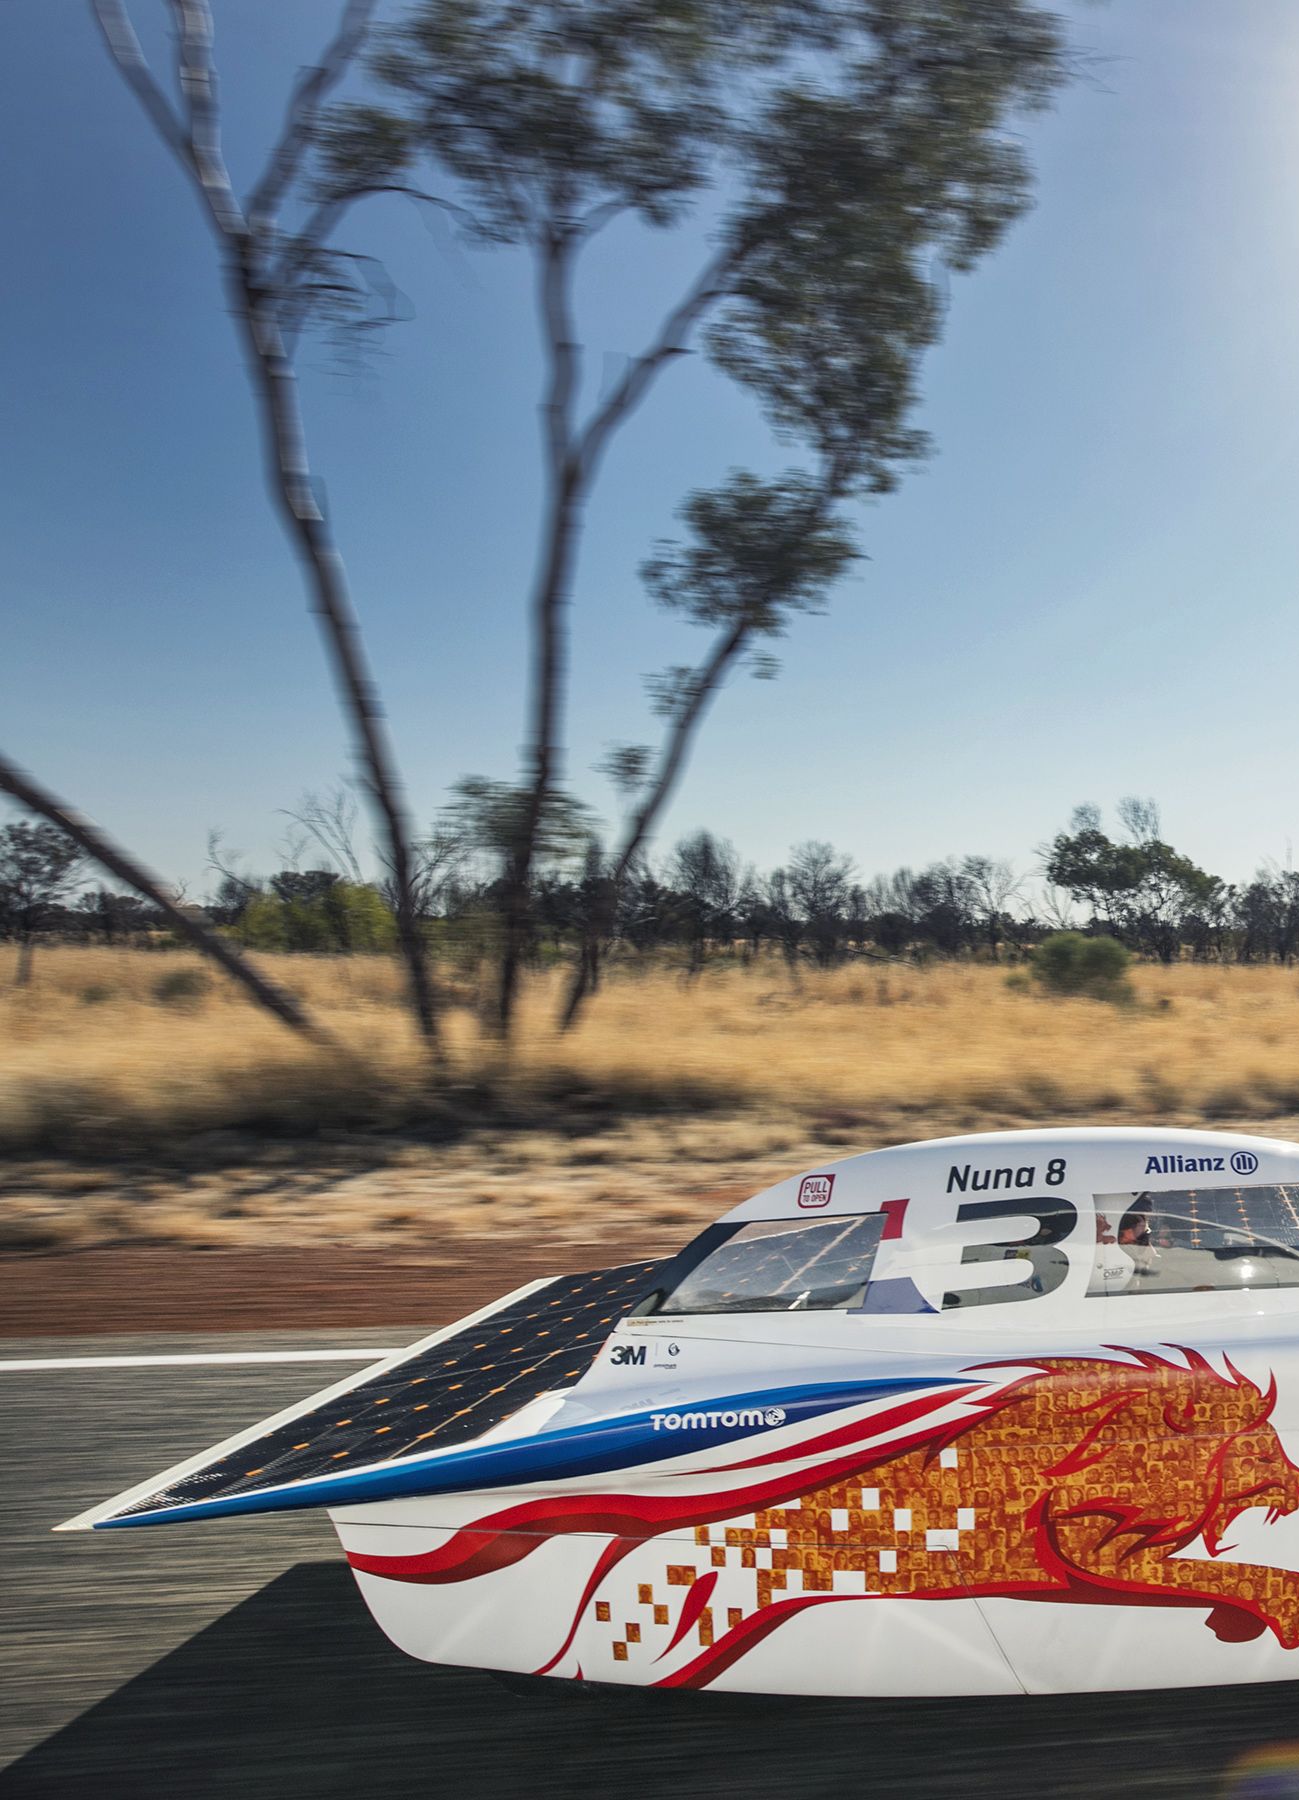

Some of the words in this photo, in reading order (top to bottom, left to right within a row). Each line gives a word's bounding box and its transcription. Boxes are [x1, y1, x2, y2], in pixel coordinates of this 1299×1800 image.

[1145, 1155, 1225, 1175] Allianz
[946, 1165, 1036, 1193] Nuna
[1045, 1158, 1067, 1186] 8
[803, 1181, 828, 1194] PULL
[811, 1193, 827, 1202] OPEN
[942, 1197, 1078, 1310] 3
[610, 1345, 647, 1366] 3M
